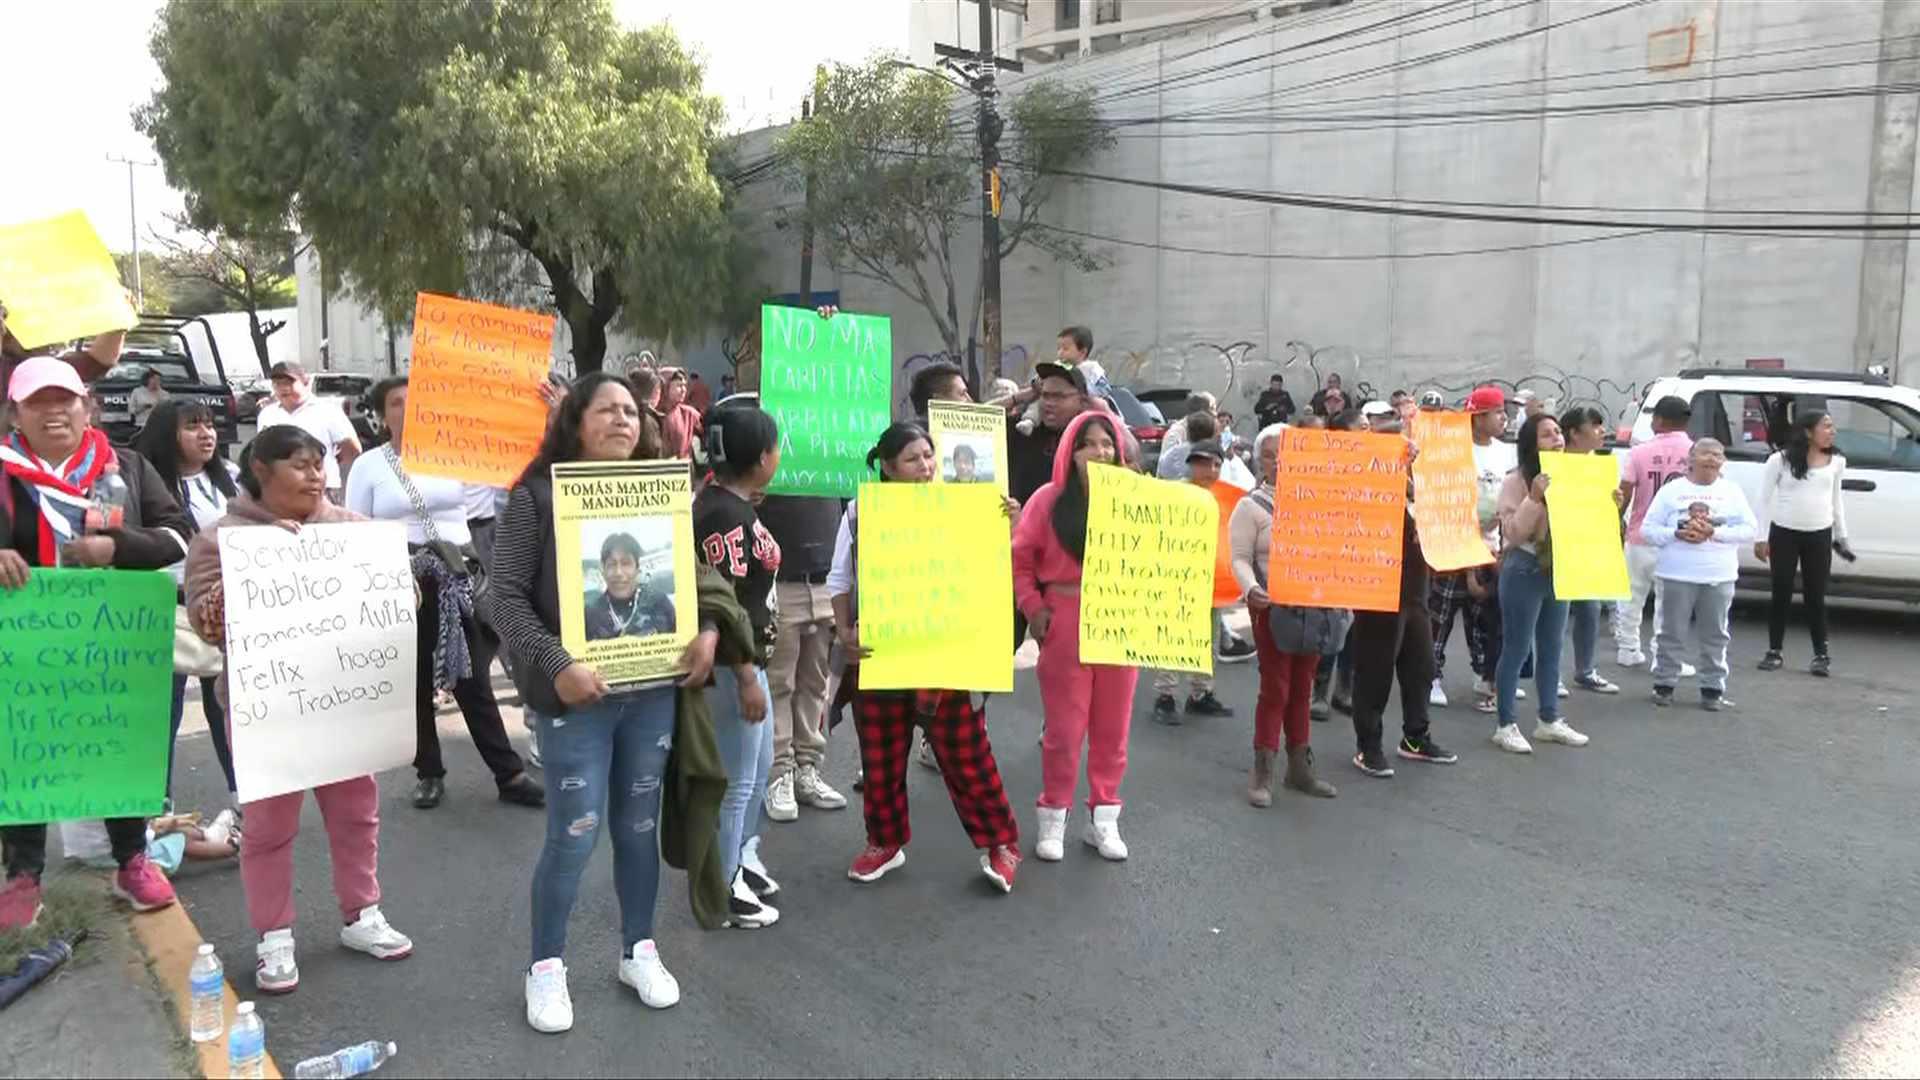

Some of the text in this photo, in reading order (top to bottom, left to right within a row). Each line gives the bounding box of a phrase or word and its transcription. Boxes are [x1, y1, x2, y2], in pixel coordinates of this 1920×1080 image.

[772, 309, 817, 352] NO
[561, 479, 688, 497] TOMÁS MARTÍNEZ
[581, 493, 671, 510] MANDUJANO
[226, 528, 347, 572] Servidor
[240, 562, 411, 609] Publico Jose
[227, 599, 414, 656] Francisco Avila
[237, 659, 304, 692] Felix
[288, 681, 393, 716] Trabajo
